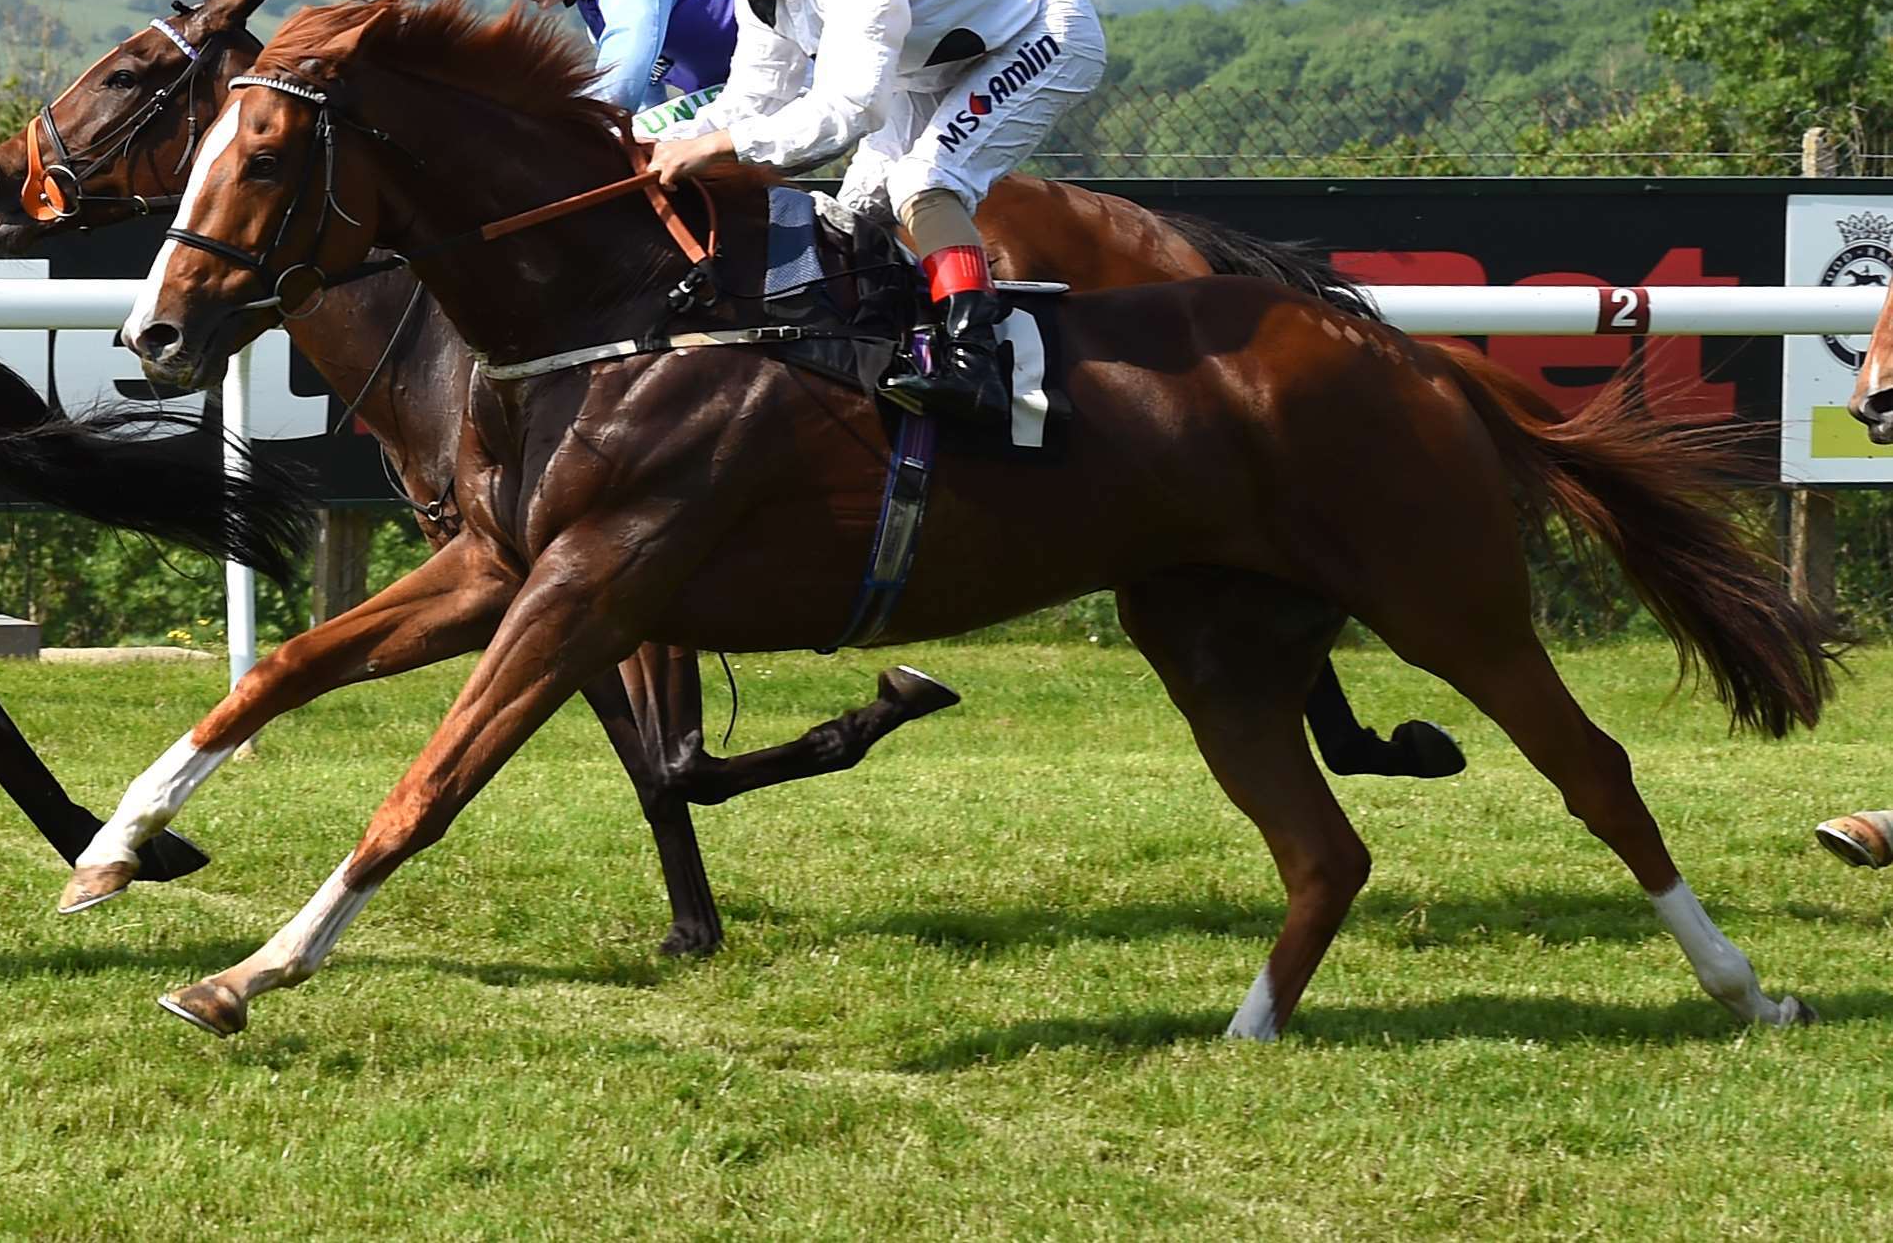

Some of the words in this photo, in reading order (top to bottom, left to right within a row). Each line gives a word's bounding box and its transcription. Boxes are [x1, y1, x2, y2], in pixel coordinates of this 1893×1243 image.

[936, 109, 980, 154] MS
[988, 34, 1061, 105] Amlin
[1610, 287, 1638, 327] 2
